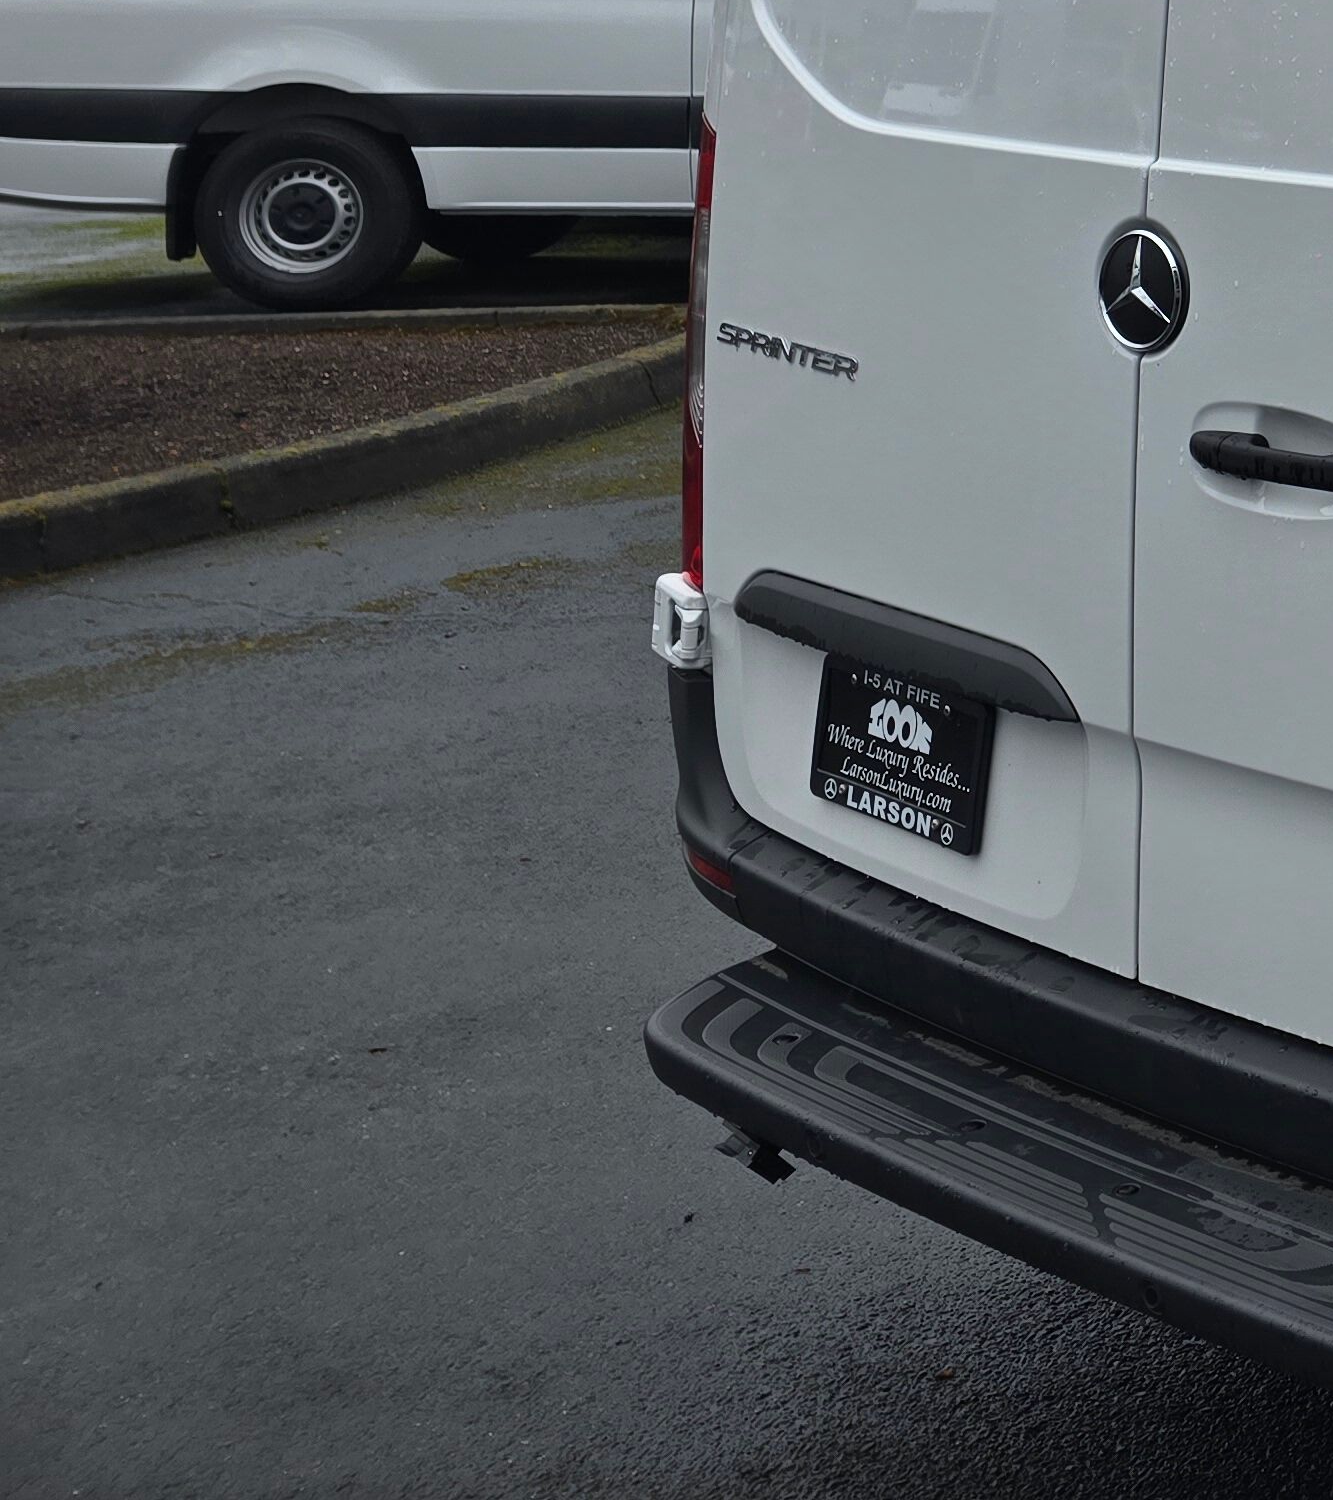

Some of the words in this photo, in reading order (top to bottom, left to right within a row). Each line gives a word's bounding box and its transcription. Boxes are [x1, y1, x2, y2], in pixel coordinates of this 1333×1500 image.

[717, 322, 859, 382] SPRINTER
[863, 670, 881, 689] I-5
[884, 678, 904, 696] AT
[907, 684, 941, 710] FIFE
[827, 723, 865, 754] Where
[866, 740, 910, 778] Luxury
[840, 756, 952, 813] LarsonLuxury.com
[846, 785, 932, 837] LARSON
